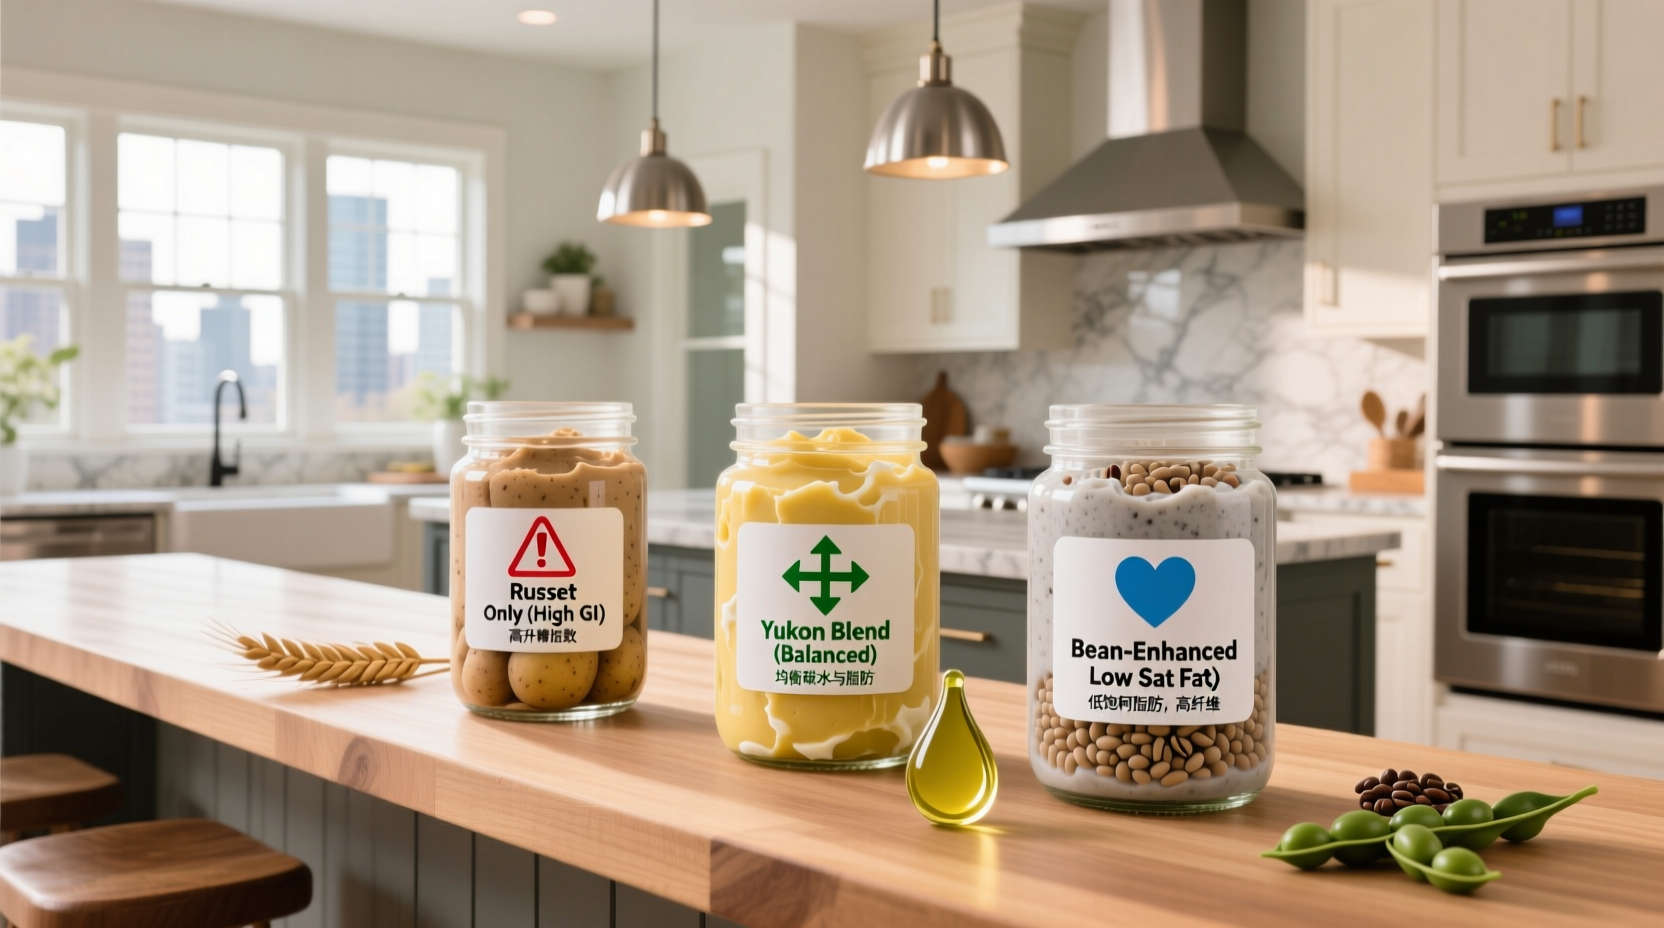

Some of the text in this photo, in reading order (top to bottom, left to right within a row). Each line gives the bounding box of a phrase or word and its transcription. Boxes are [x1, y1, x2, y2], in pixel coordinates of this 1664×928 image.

[510, 582, 577, 601] Russet
[483, 603, 606, 627] Only (High GI)
[760, 619, 891, 641] Yukon Blend
[773, 643, 878, 667] (Balanced)
[1071, 637, 1238, 662] Bean-Enhanced
[1089, 665, 1221, 692] Low Sat Fat)
